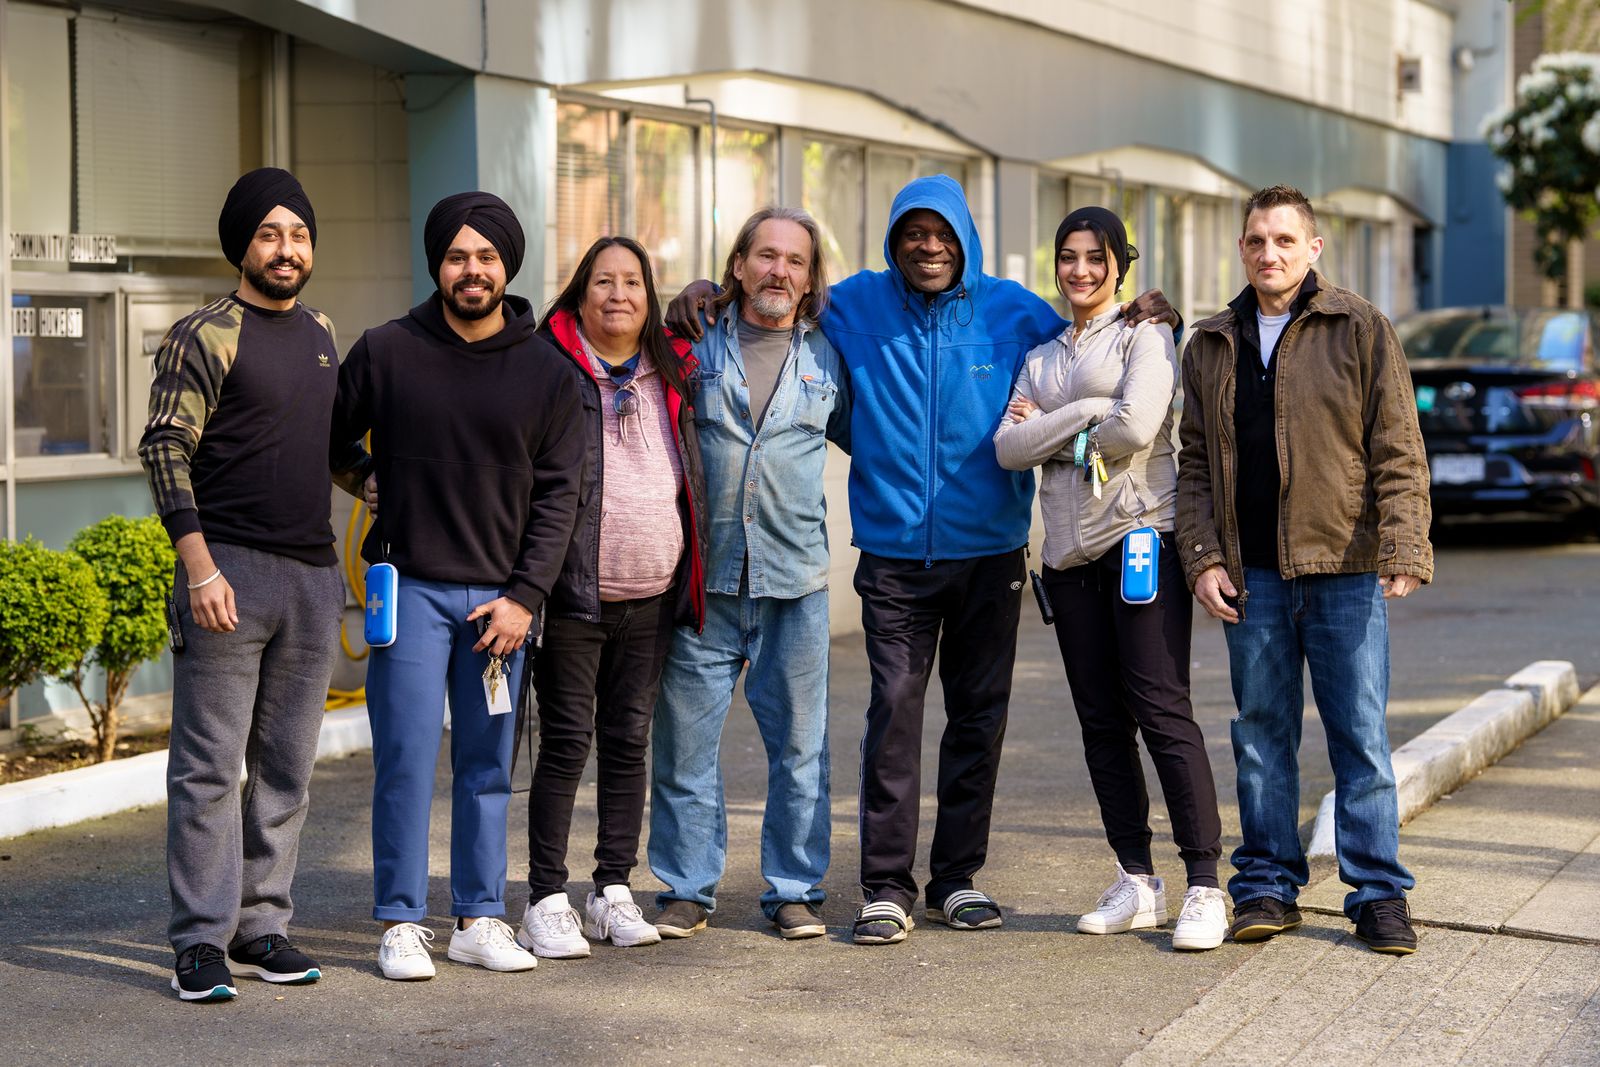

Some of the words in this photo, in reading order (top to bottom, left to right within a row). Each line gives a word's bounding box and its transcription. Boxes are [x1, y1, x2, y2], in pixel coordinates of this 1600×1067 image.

[70, 236, 115, 260] BUILDERS
[41, 310, 65, 334] HOWE
[69, 311, 81, 334] ST
